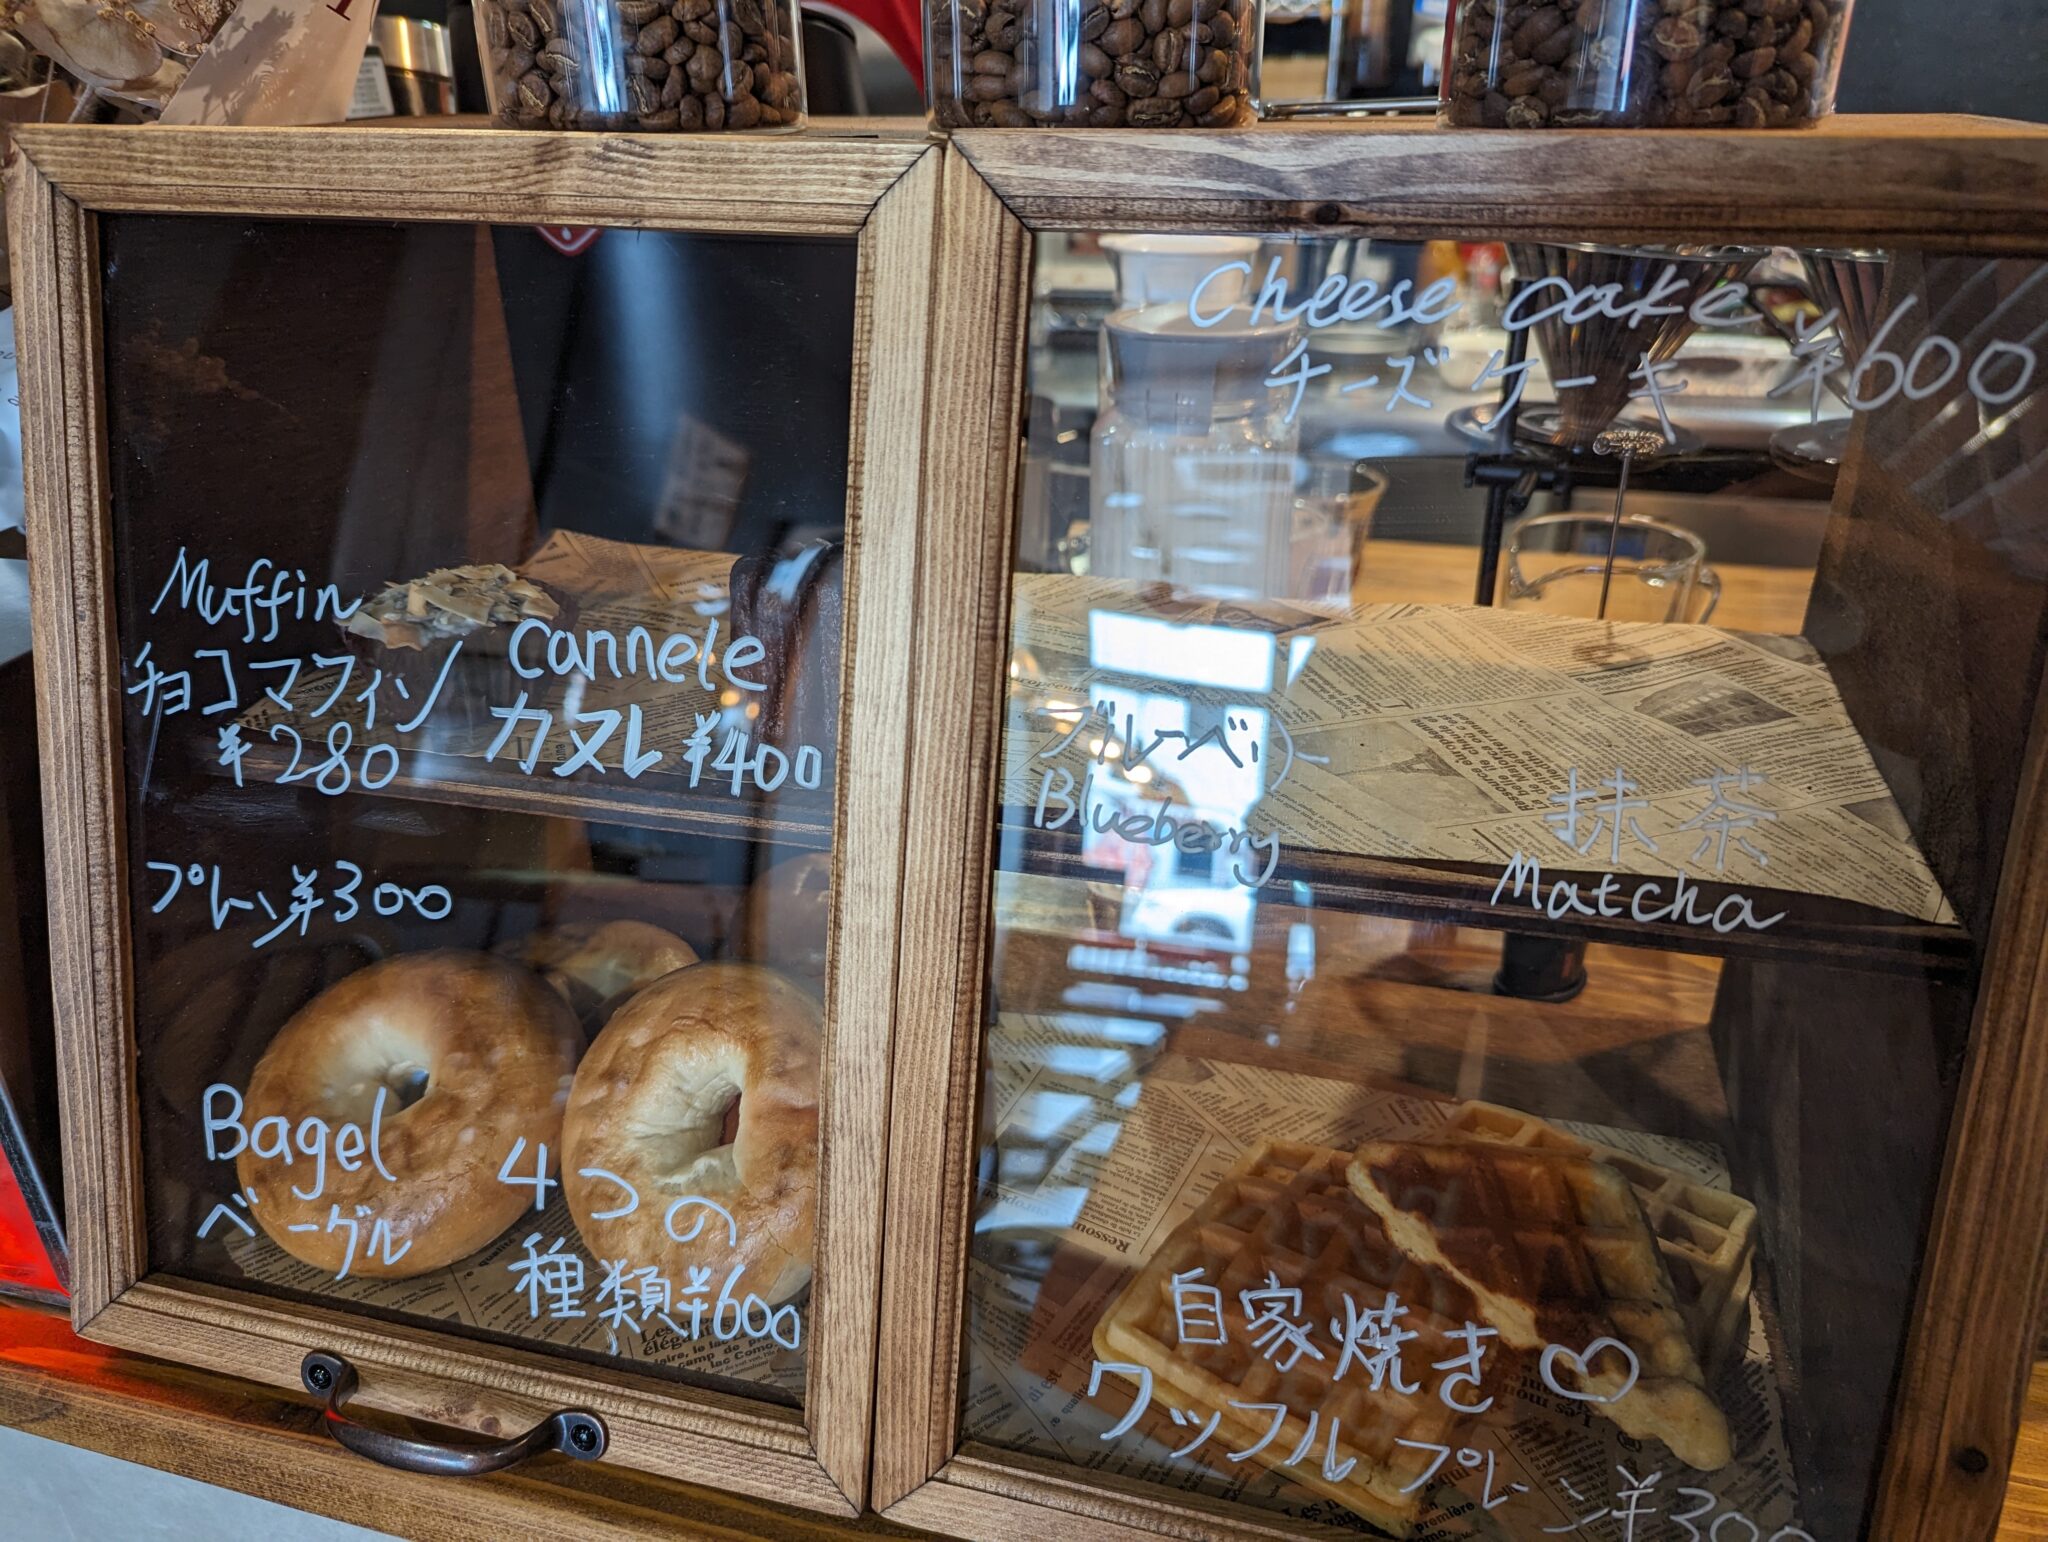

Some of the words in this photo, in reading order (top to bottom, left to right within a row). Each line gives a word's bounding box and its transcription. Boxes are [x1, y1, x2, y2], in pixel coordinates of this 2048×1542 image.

[1188, 255, 1463, 329] Cheese
[1263, 337, 1689, 445] チーズケーキ
[151, 546, 363, 643] Muffin
[218, 721, 400, 796] ¥280
[1542, 763, 1780, 871] 抹茶
[1490, 849, 1791, 934] Matcha
[201, 1083, 398, 1200] Bagel
[196, 1186, 413, 1282] ベーグル
[1169, 1267, 1499, 1414] 自家焼き
